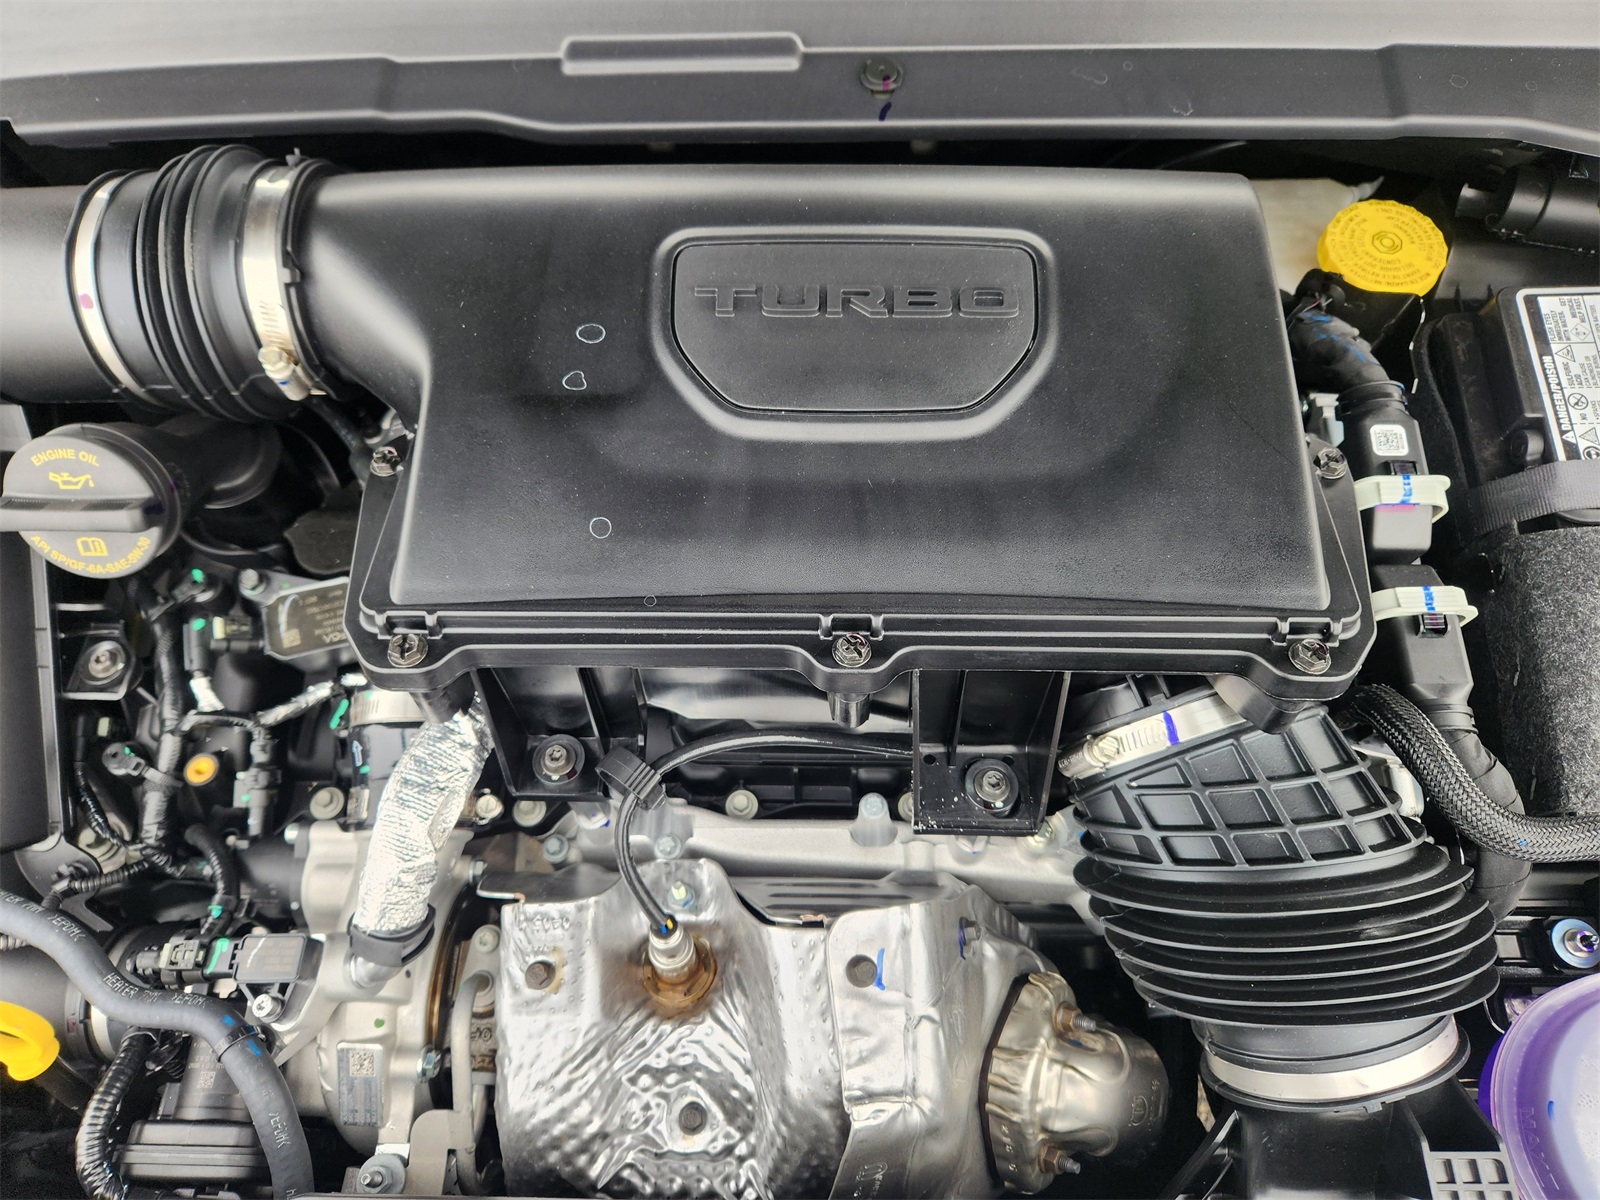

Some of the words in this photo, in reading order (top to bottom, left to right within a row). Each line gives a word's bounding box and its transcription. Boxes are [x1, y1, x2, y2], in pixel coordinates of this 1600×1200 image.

[694, 283, 1019, 318] TURBO
[1544, 313, 1552, 325] EYES
[1563, 320, 1571, 341] WITH
[1562, 362, 1575, 386] SULFURIC
[1579, 363, 1588, 376] CAUSE
[1574, 374, 1584, 386] ACID
[1542, 355, 1572, 431] DANGER/POISON
[31, 448, 76, 467] ENGINE
[78, 451, 100, 467] OIL
[30, 535, 51, 553] API
[103, 972, 138, 999] HEATER
